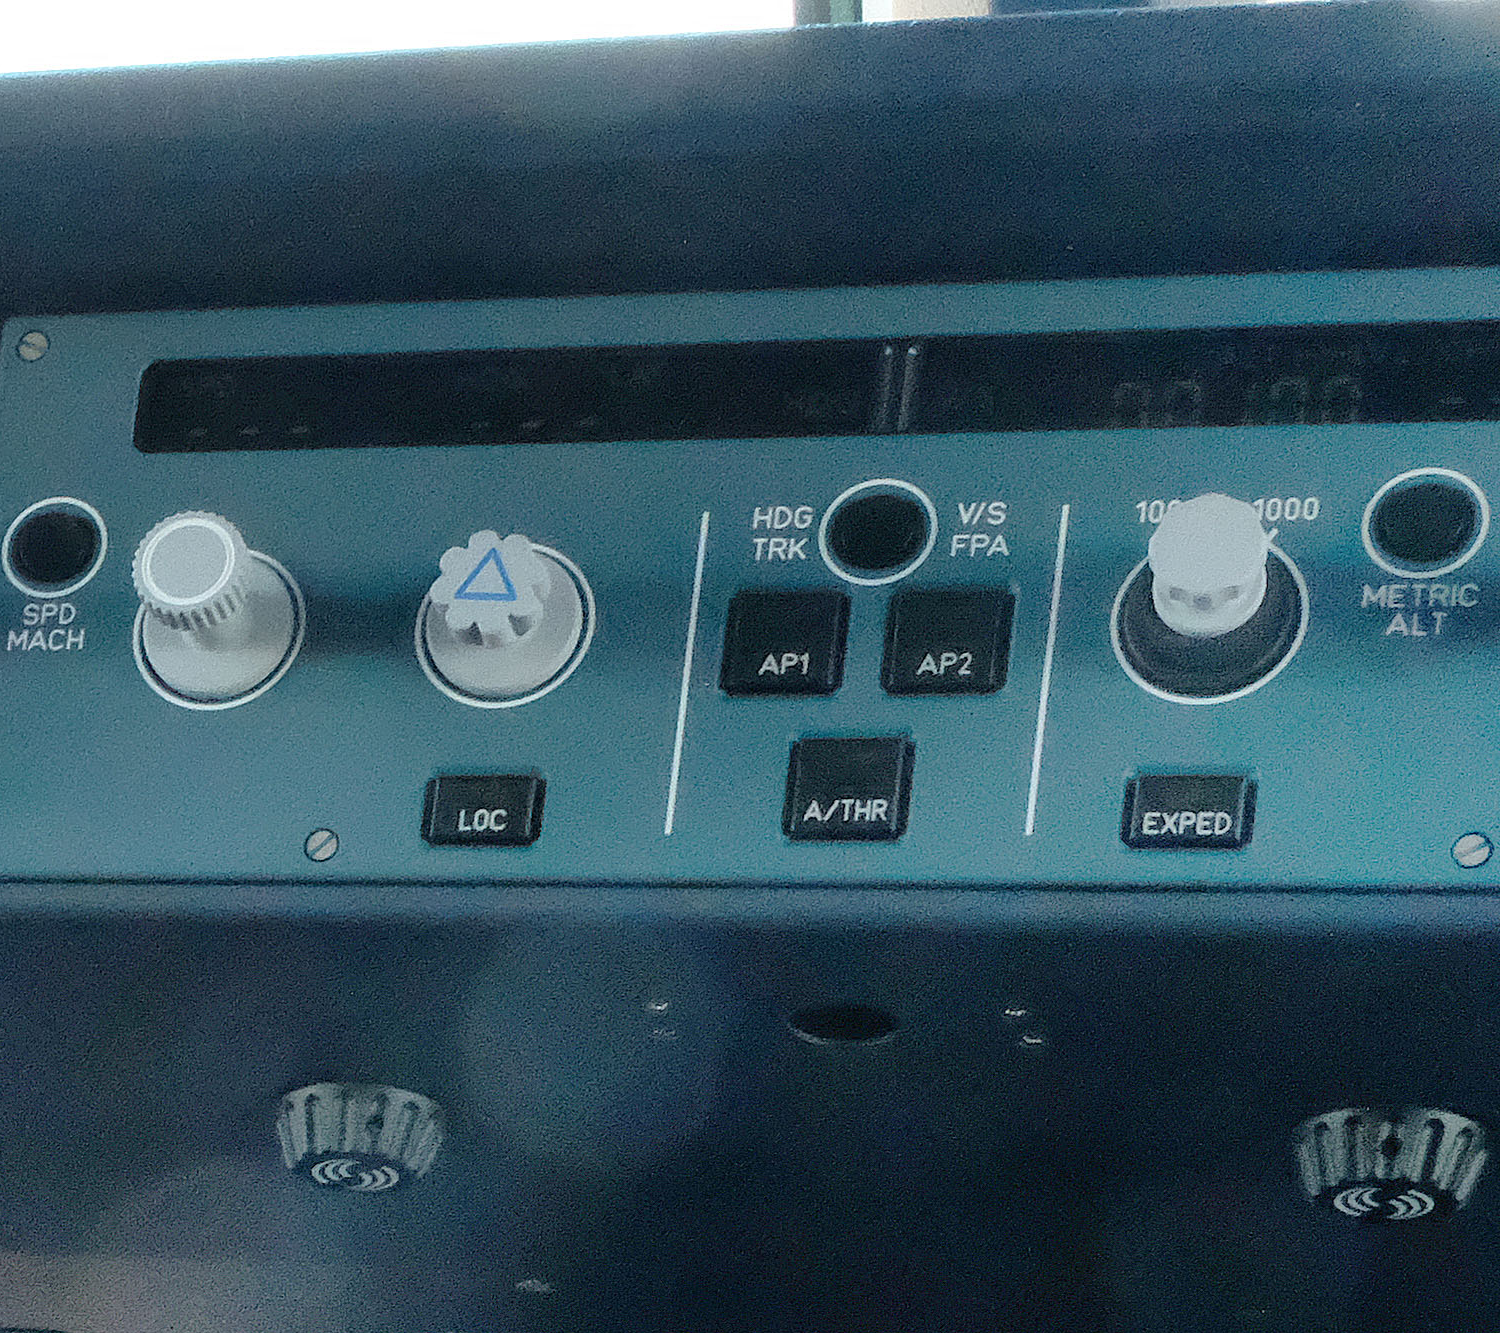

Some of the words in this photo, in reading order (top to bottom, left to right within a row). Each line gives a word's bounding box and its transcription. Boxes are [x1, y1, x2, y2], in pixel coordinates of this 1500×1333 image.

[752, 507, 813, 530] HDG
[956, 501, 1008, 528] V/S
[751, 536, 808, 561] TRK
[950, 534, 1010, 558] FPA
[1361, 584, 1479, 608] METRIC
[21, 604, 78, 626] SPD
[1385, 611, 1447, 636] ALT
[6, 626, 85, 653] MACH
[759, 652, 811, 676] AP1
[916, 651, 975, 676] AP2
[457, 807, 508, 833] LOC
[802, 796, 888, 825] A/THR
[1141, 809, 1233, 836] EXPED
